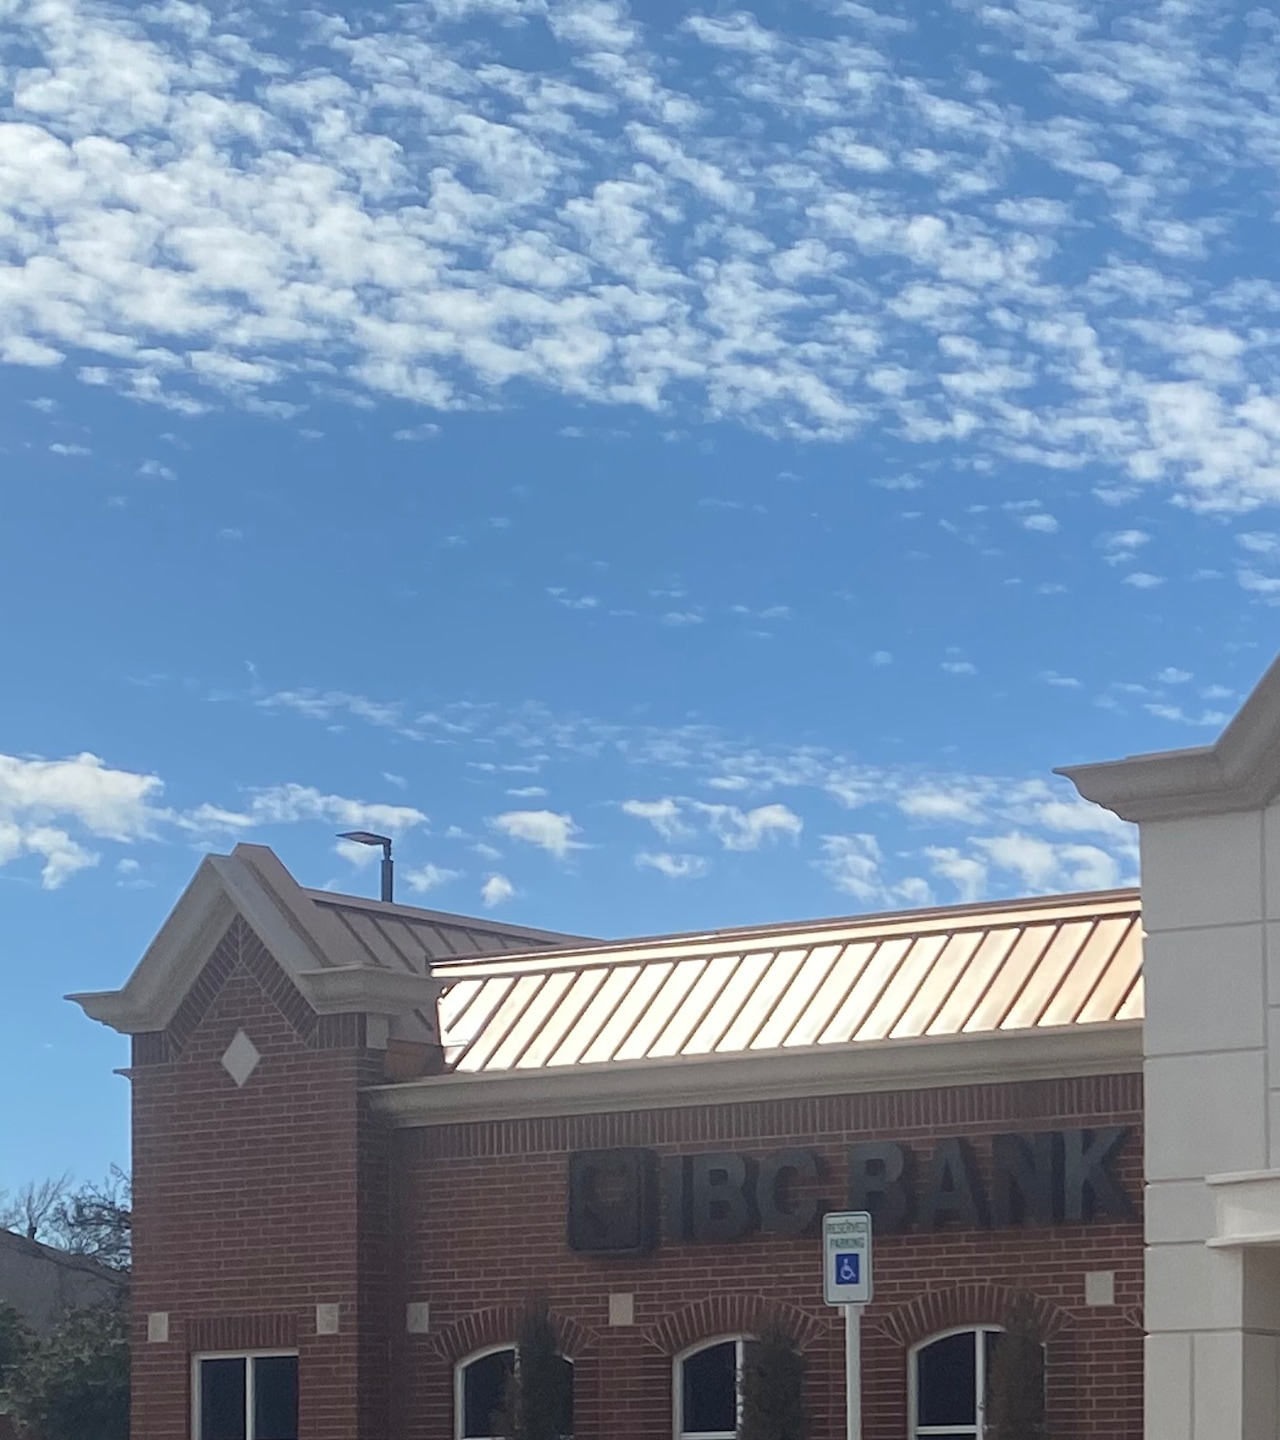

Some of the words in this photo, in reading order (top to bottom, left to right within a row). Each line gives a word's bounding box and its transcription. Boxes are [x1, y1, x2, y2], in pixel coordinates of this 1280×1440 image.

[662, 1147, 822, 1245] IBC
[846, 1125, 1135, 1231] BANK
[830, 1237, 865, 1249] PARKING
